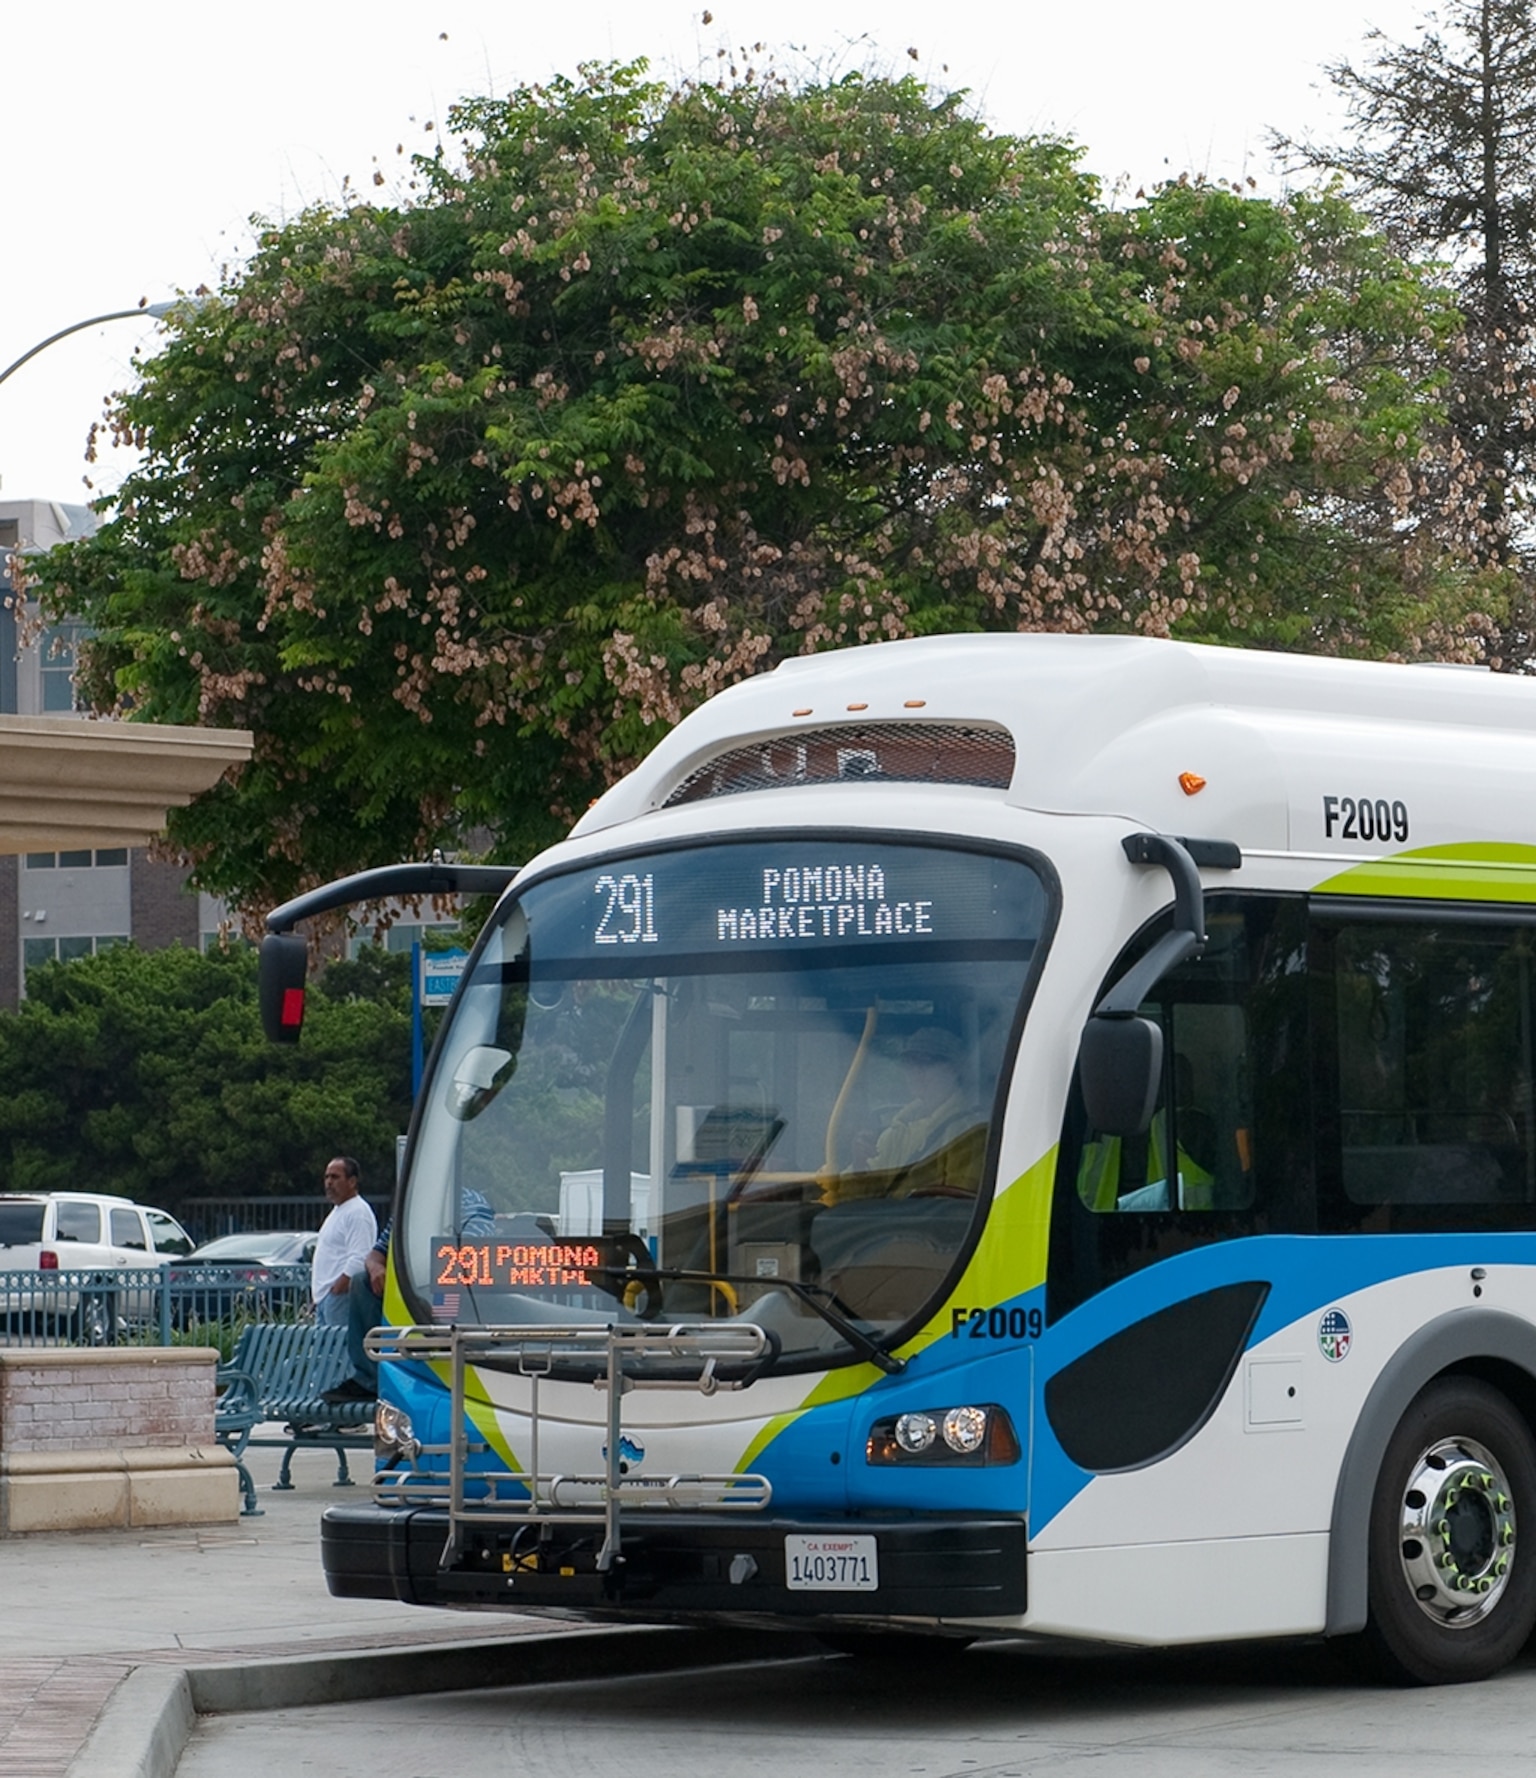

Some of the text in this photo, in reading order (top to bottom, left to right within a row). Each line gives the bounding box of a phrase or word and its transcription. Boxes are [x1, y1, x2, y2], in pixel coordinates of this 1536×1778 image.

[1322, 795, 1409, 843] F2009
[763, 864, 885, 904] POMONA
[594, 873, 659, 944] 291
[717, 901, 933, 940] MARKETPLACE
[436, 1243, 494, 1286] 291
[495, 1244, 600, 1267] POMONA
[951, 1307, 1043, 1340] F2009
[807, 1543, 854, 1552] CA EXEMPT
[792, 1555, 871, 1582] 1403771
